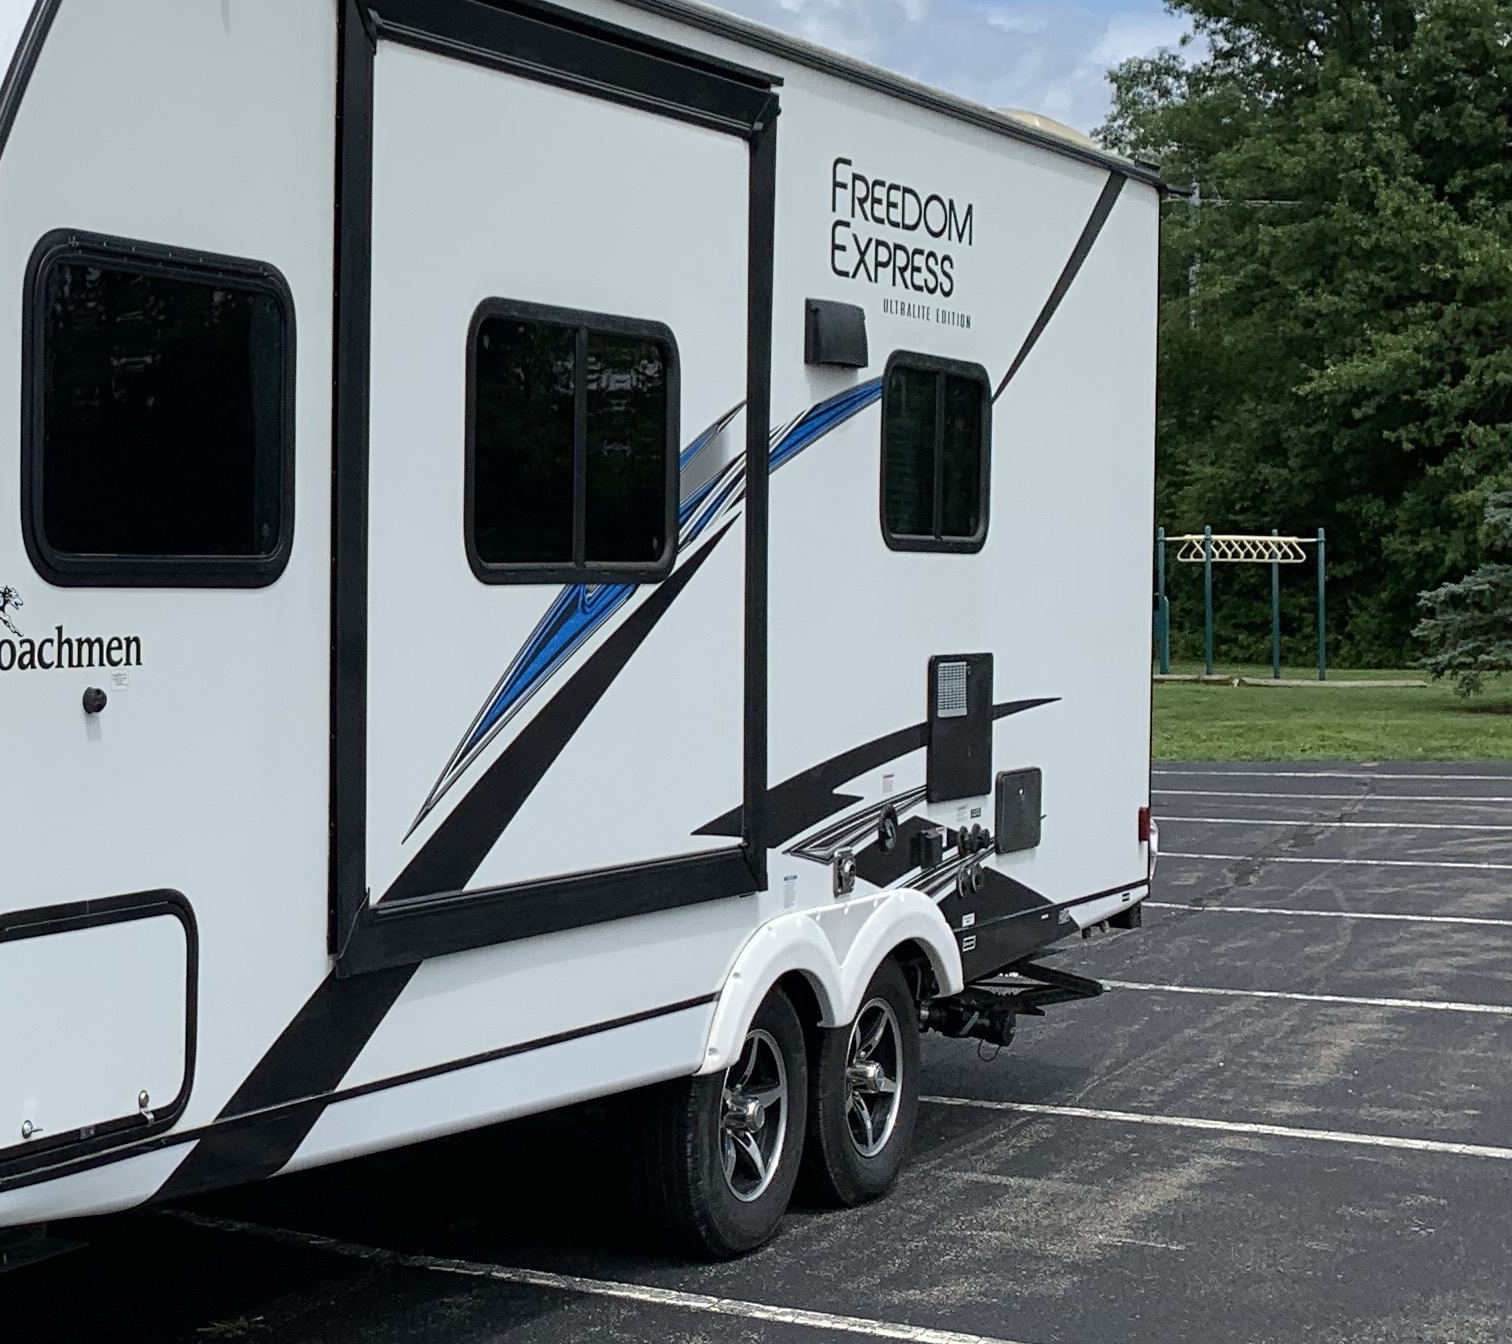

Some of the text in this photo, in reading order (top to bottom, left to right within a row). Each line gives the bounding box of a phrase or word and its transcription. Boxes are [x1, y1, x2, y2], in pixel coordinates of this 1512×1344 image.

[831, 156, 974, 246] FREEDOM
[830, 219, 954, 298] EXPRESS
[882, 297, 972, 330] ULTRALITE EDITION
